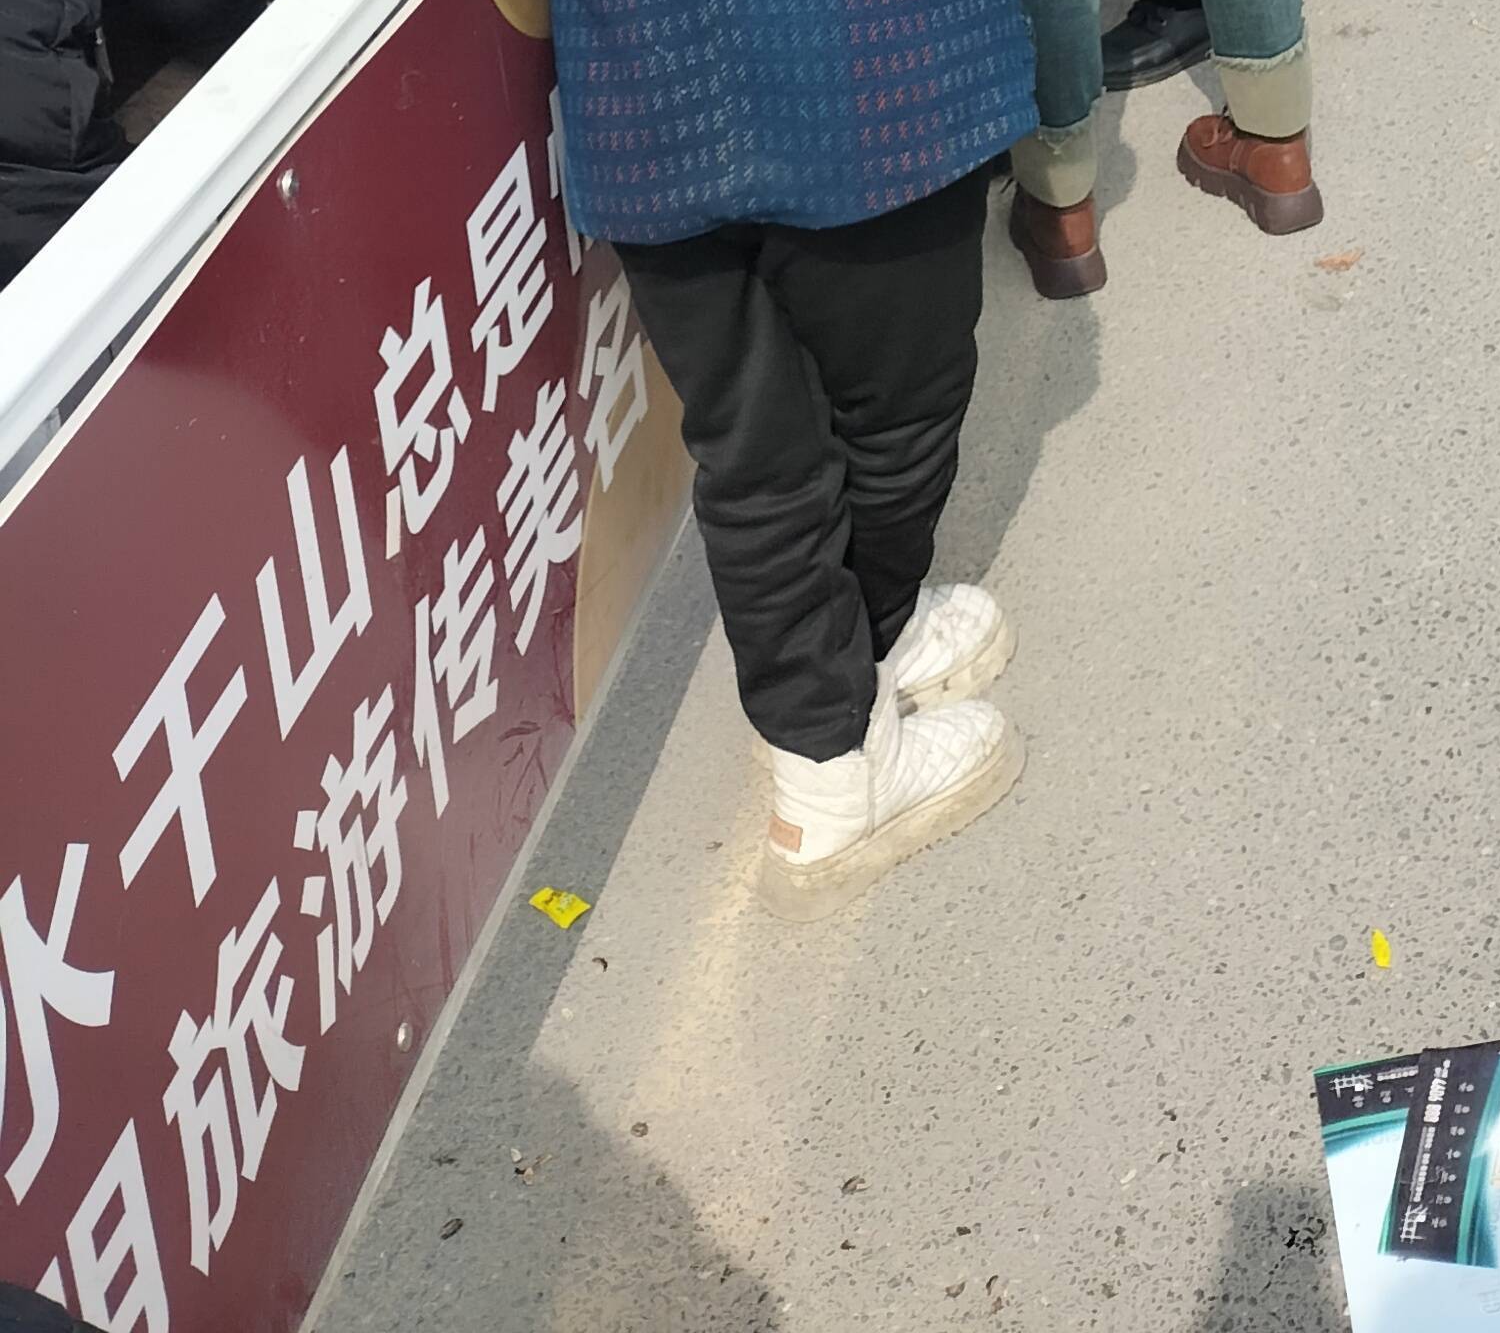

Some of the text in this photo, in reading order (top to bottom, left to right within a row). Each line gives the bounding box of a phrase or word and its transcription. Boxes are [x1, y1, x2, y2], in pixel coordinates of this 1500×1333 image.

[0, 85, 583, 1205] 水千山总是
